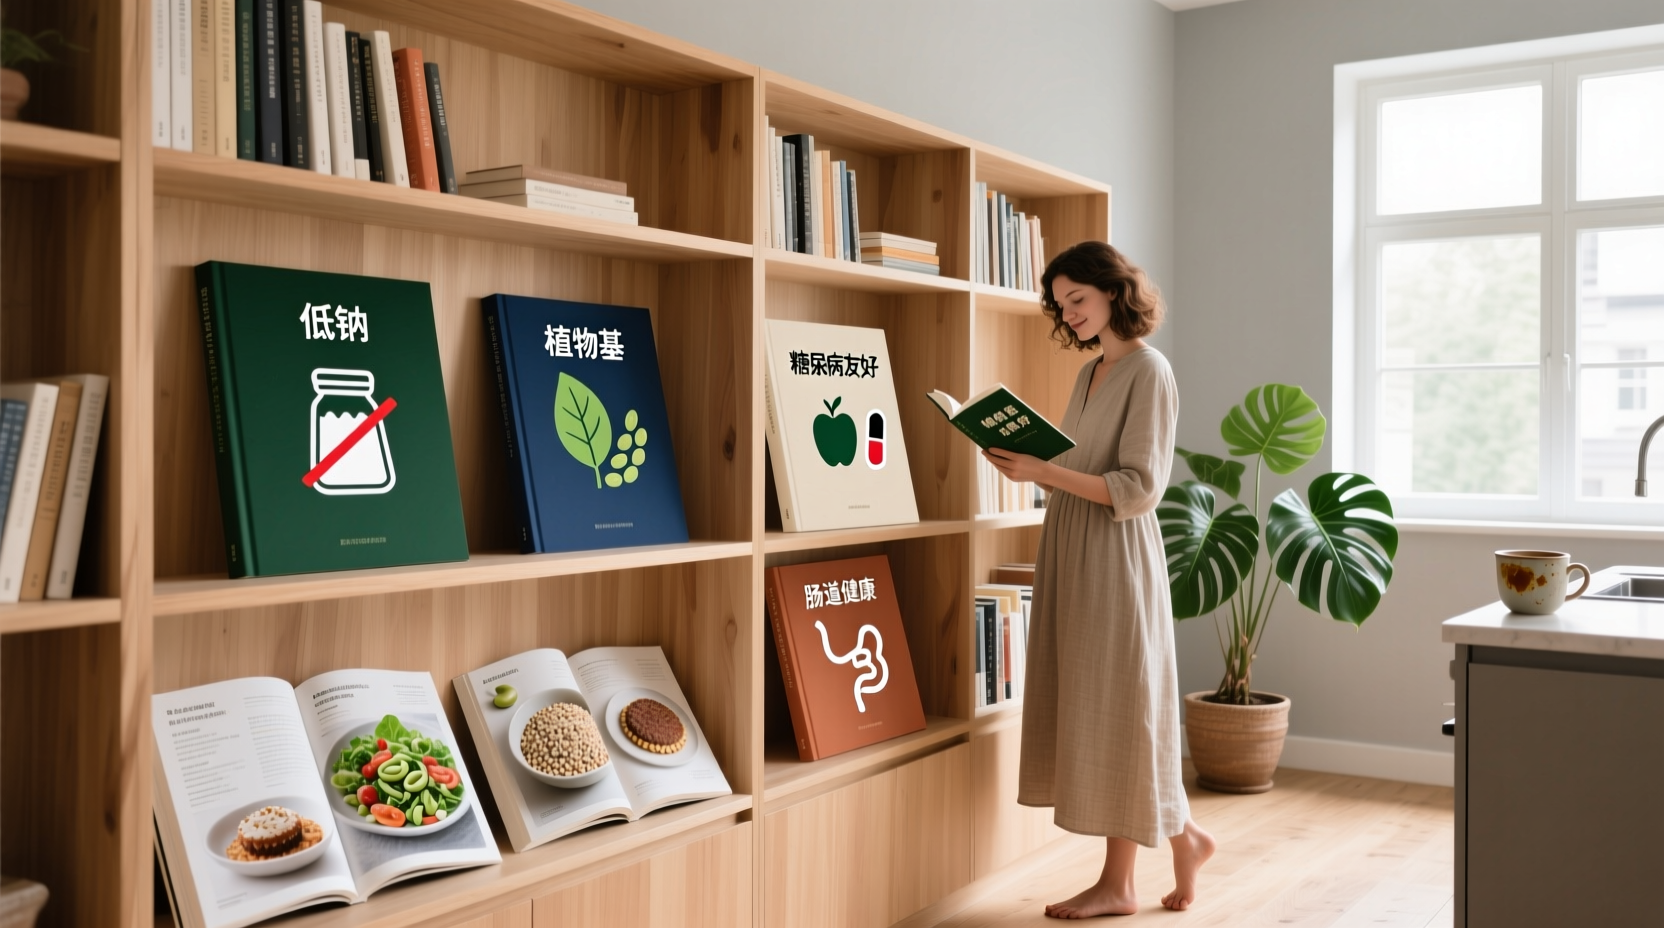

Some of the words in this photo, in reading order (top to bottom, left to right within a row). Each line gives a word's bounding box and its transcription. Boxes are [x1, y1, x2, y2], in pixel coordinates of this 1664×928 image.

[299, 302, 369, 343] 低钠
[544, 324, 624, 361] 植物基
[804, 577, 877, 610] 肠道健康
